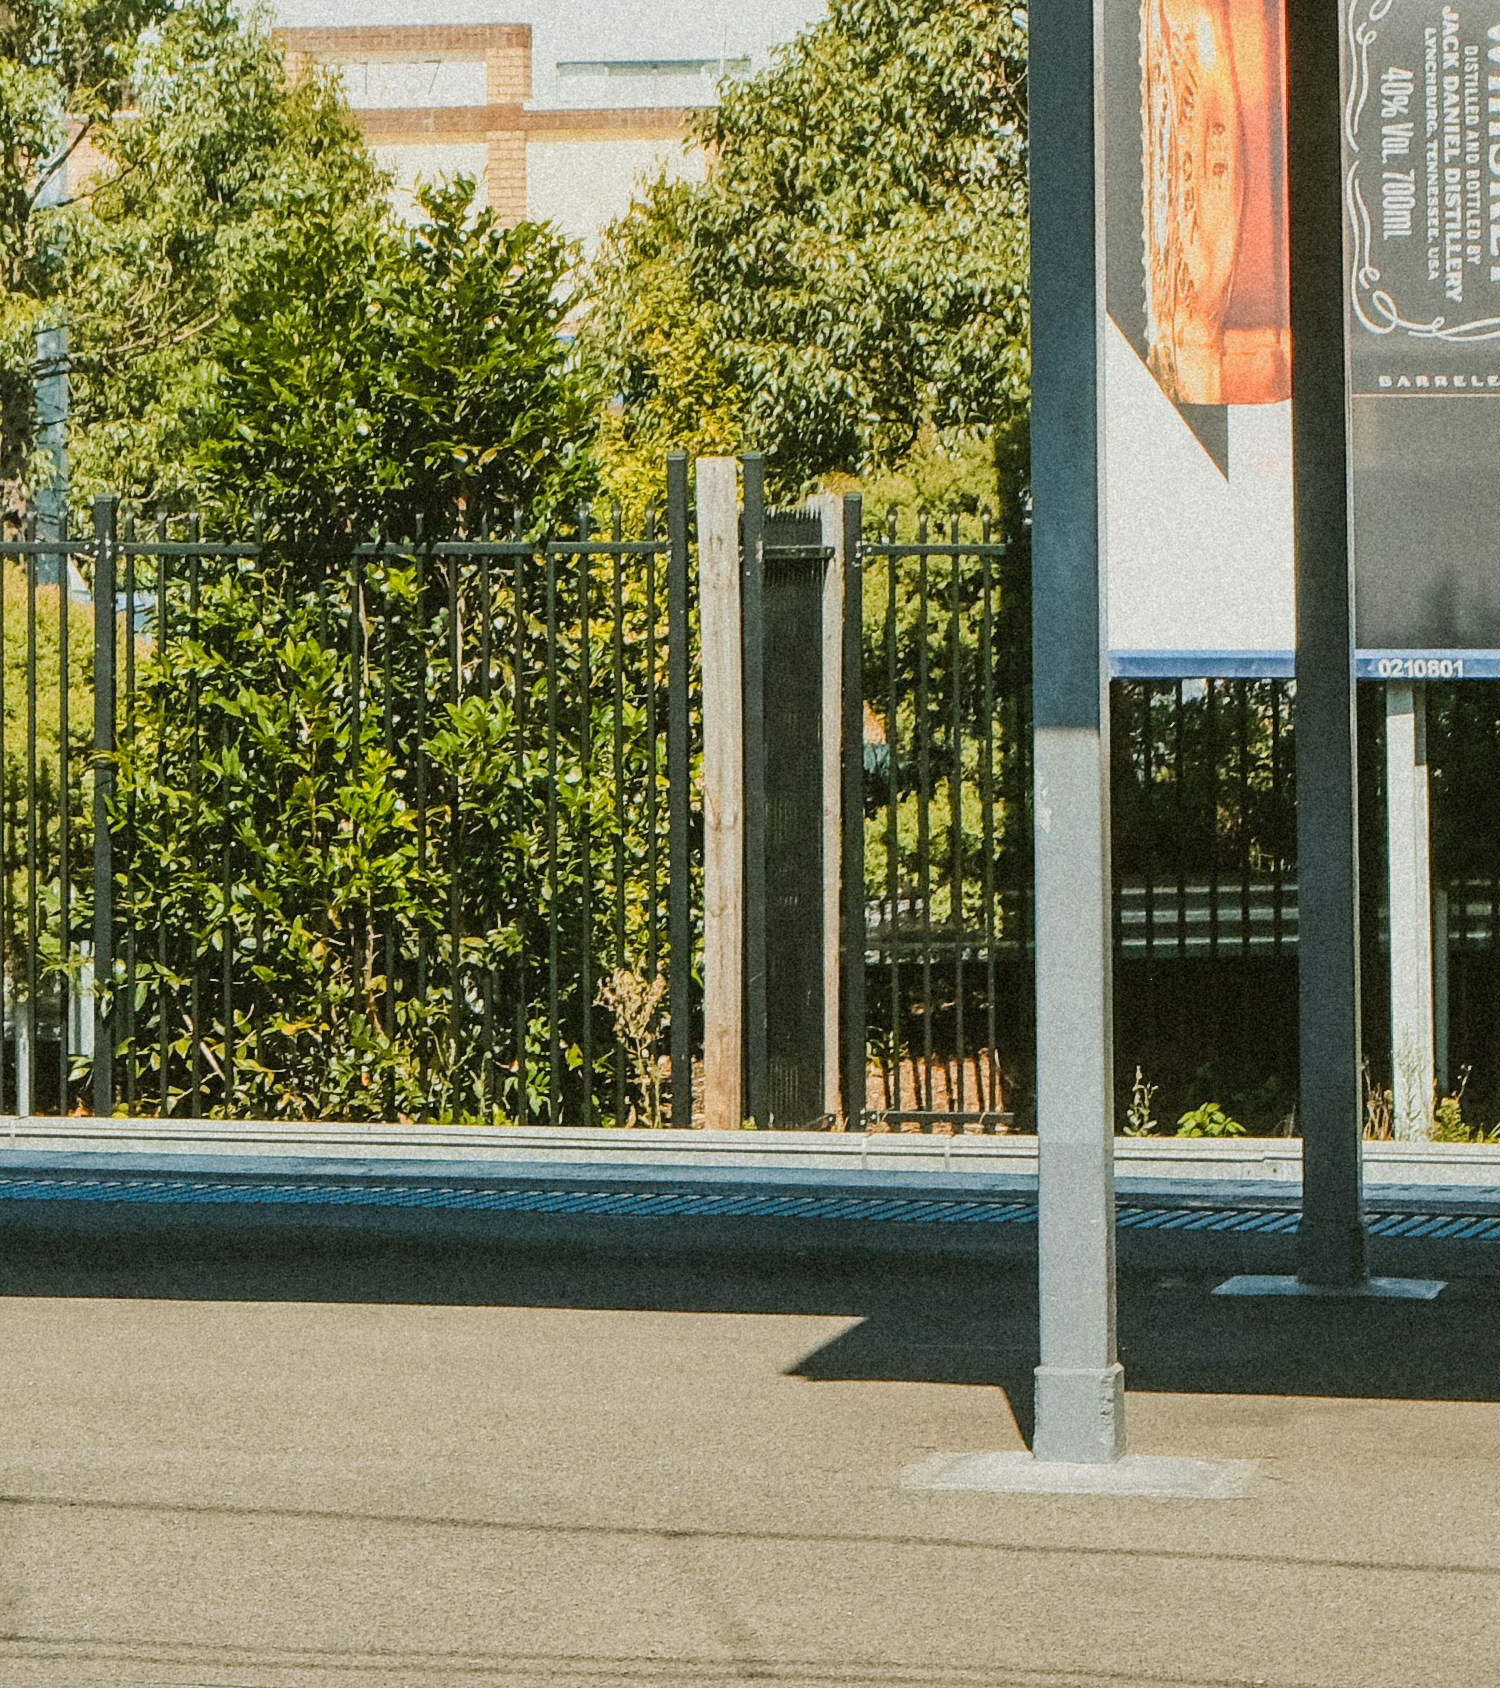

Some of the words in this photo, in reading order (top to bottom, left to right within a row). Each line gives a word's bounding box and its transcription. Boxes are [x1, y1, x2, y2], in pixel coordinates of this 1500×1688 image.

[1441, 5, 1460, 69] JACK
[1380, 66, 1415, 118] 40%
[1464, 45, 1480, 126] DISTILLED
[1442, 75, 1461, 163] DANIEL
[1464, 130, 1480, 164] AND
[1465, 169, 1481, 240] BOTTLED
[1427, 247, 1440, 281] USA
[1444, 167, 1463, 303] DISTILLERY
[1466, 244, 1481, 265] BY
[1378, 658, 1465, 678] 0210801
